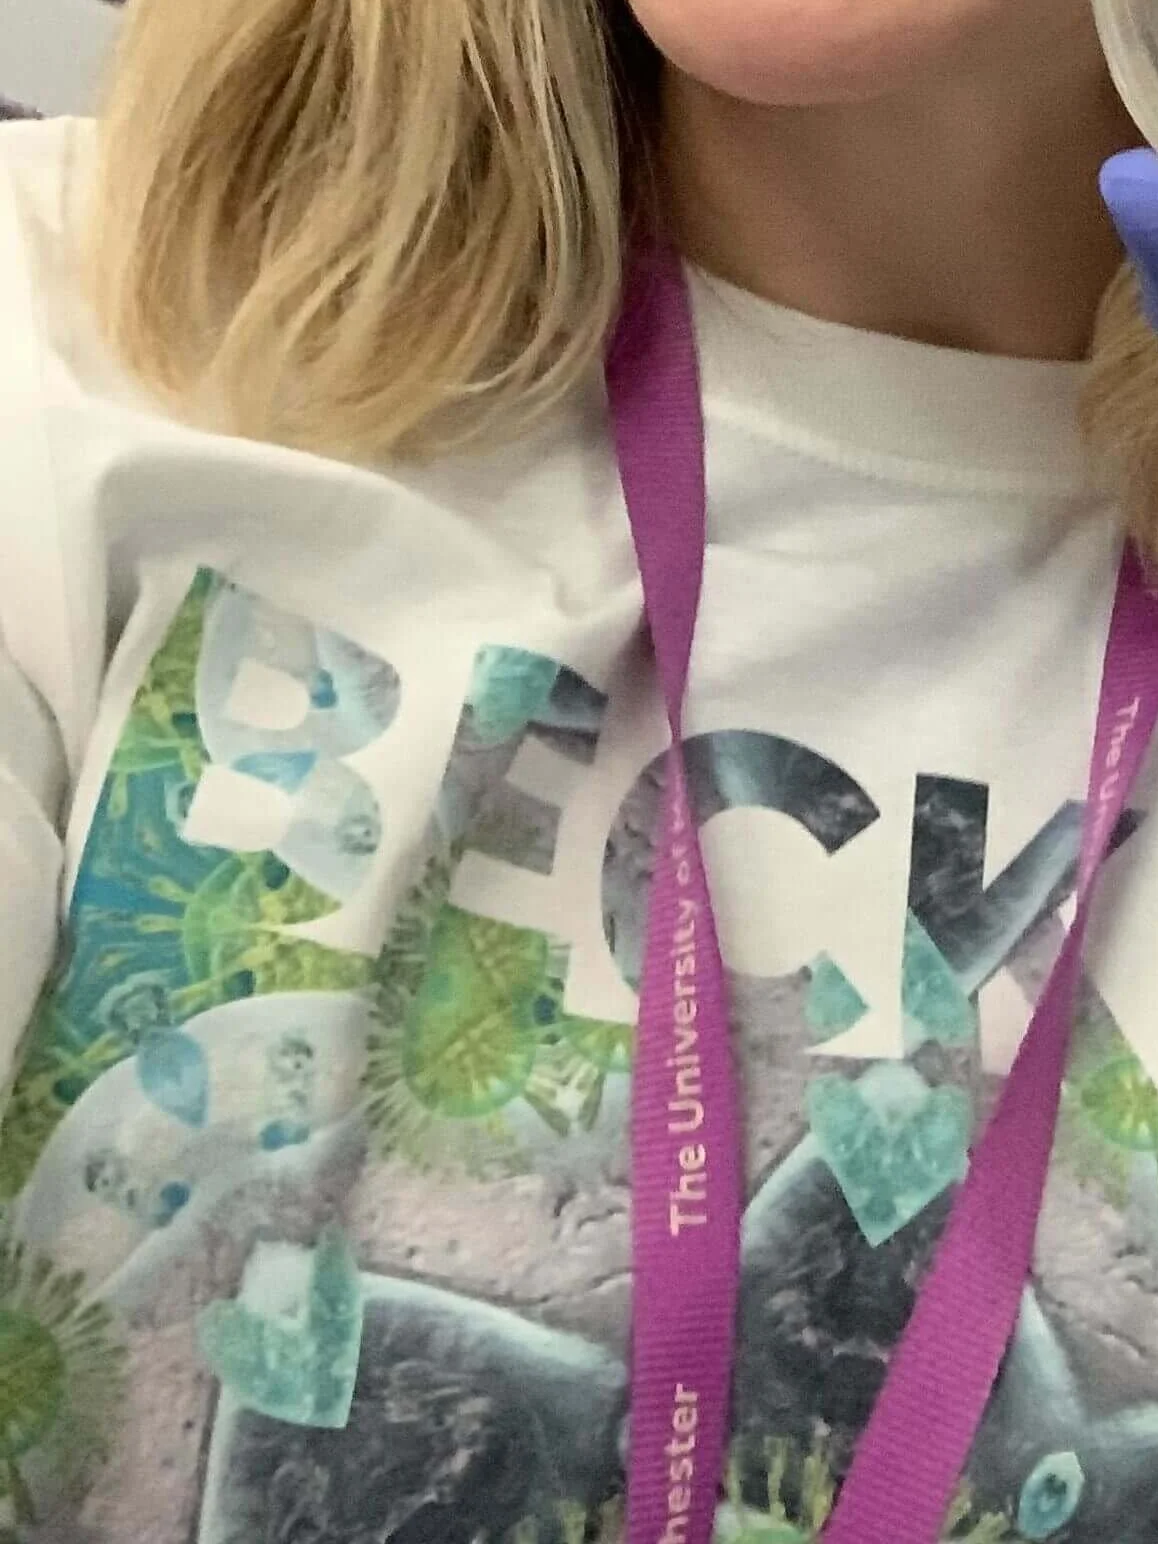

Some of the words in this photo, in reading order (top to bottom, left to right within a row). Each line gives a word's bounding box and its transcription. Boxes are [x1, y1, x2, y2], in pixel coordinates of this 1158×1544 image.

[1105, 696, 1141, 770] The
[666, 898, 705, 1134] University
[670, 1142, 707, 1237] The
